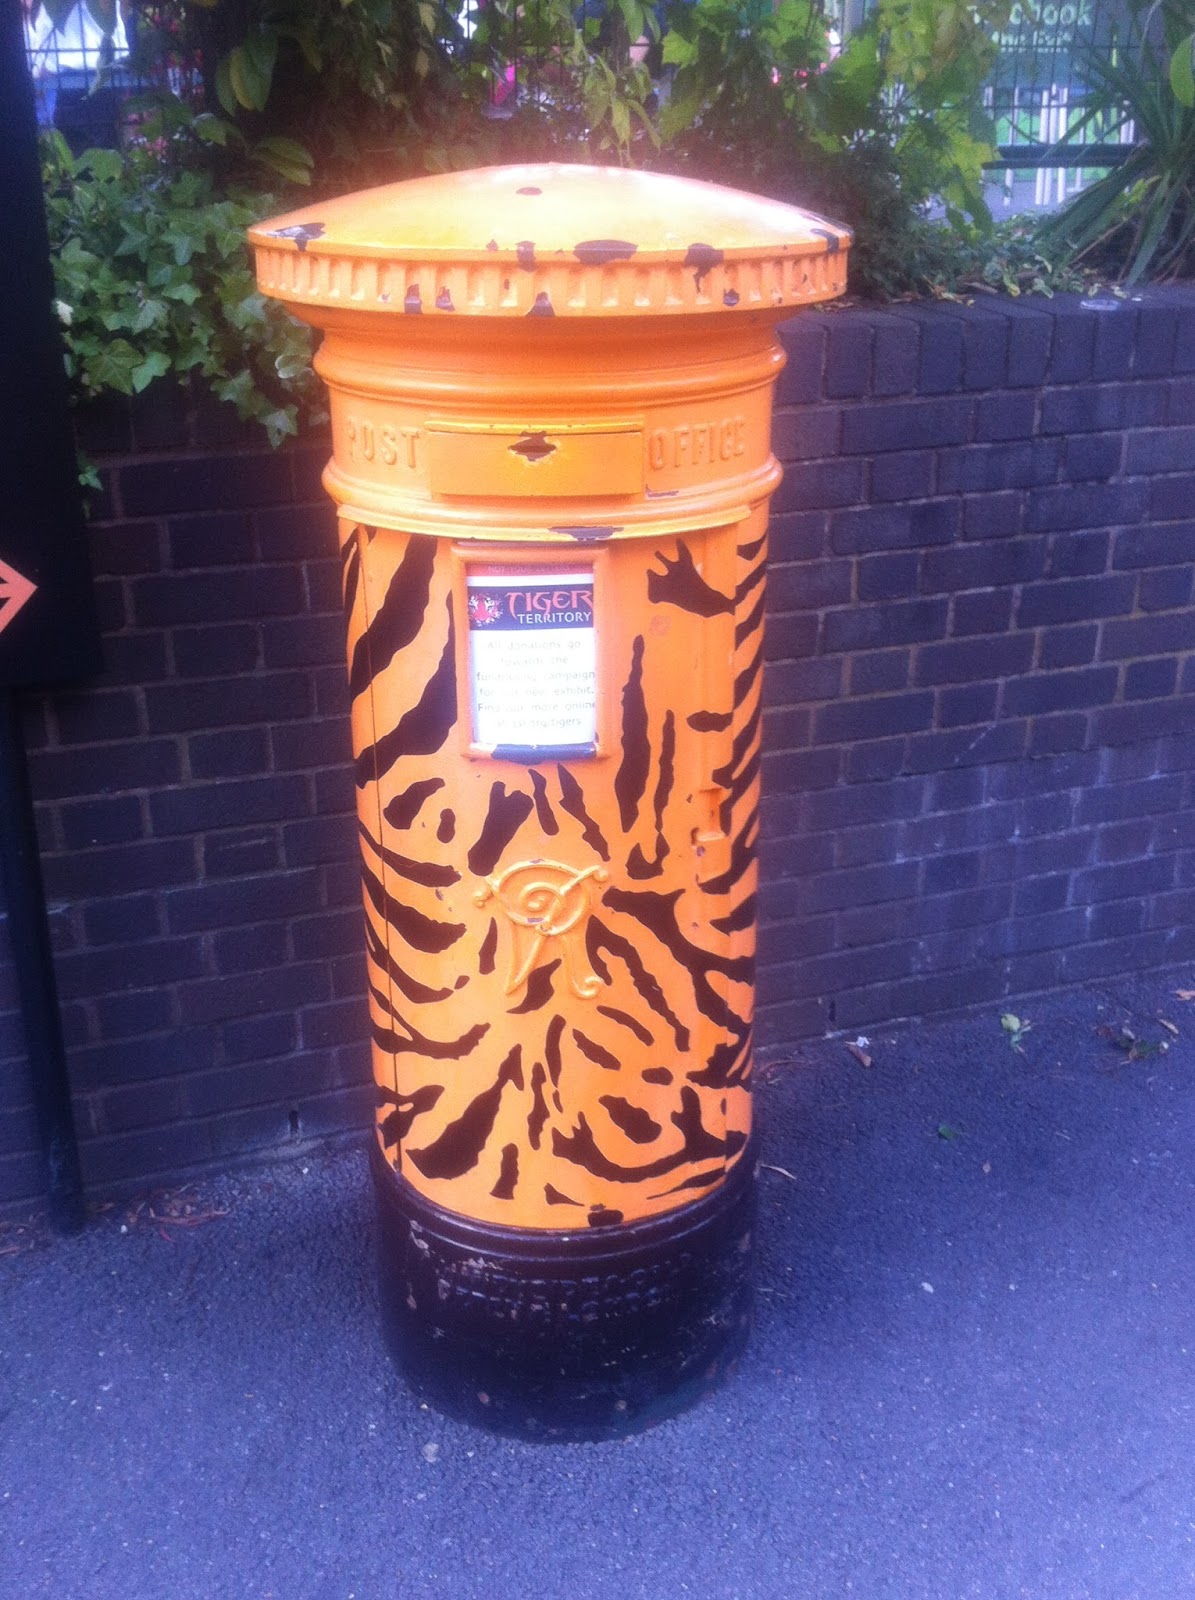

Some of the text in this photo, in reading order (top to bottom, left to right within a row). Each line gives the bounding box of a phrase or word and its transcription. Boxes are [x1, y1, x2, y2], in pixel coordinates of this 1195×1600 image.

[345, 413, 420, 469] POST
[648, 416, 746, 471] OFFICE
[504, 590, 593, 620] TIGER
[517, 611, 591, 625] TERRITORY
